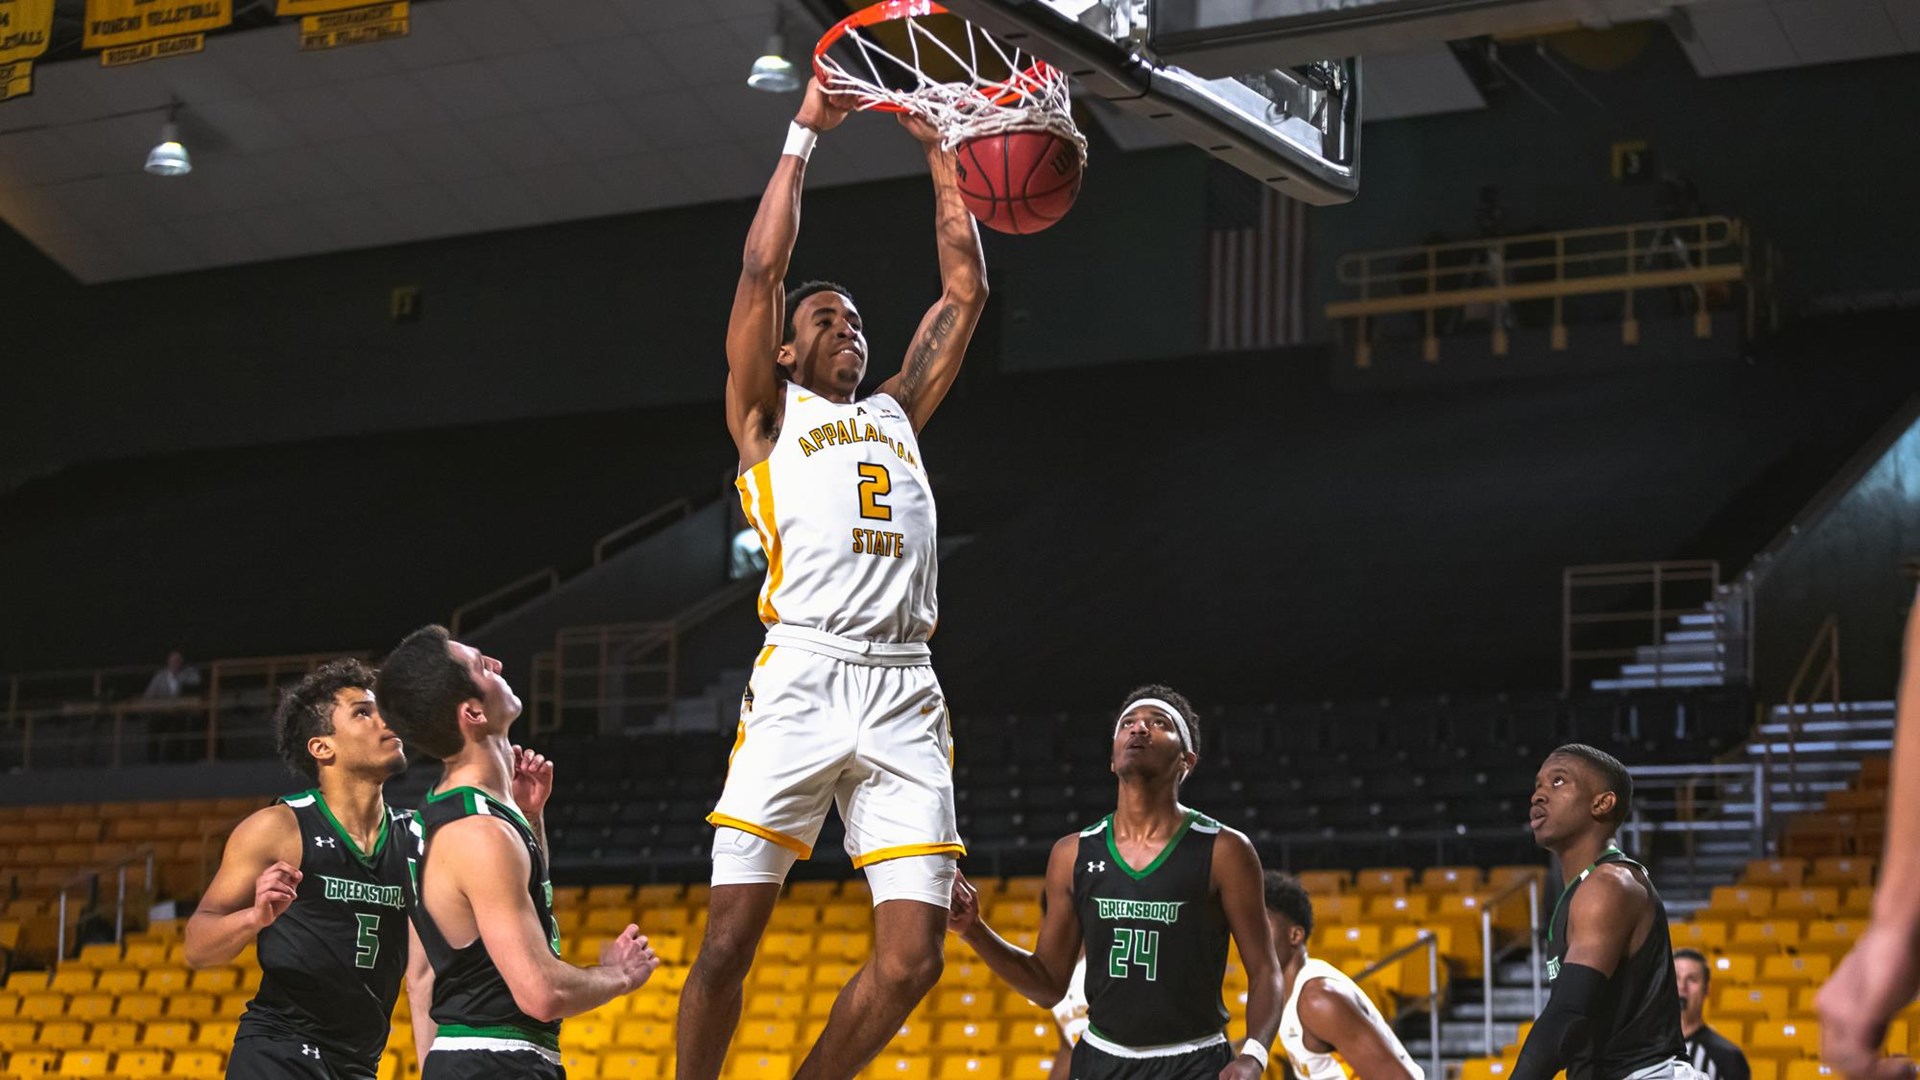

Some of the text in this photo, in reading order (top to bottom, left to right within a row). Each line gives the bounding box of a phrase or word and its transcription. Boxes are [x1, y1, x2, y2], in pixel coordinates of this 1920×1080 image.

[857, 461, 892, 522] 2
[852, 527, 904, 559] STATE
[1092, 897, 1187, 926] GREENSBORO
[355, 912, 380, 969] 5
[1109, 927, 1160, 981] 24
